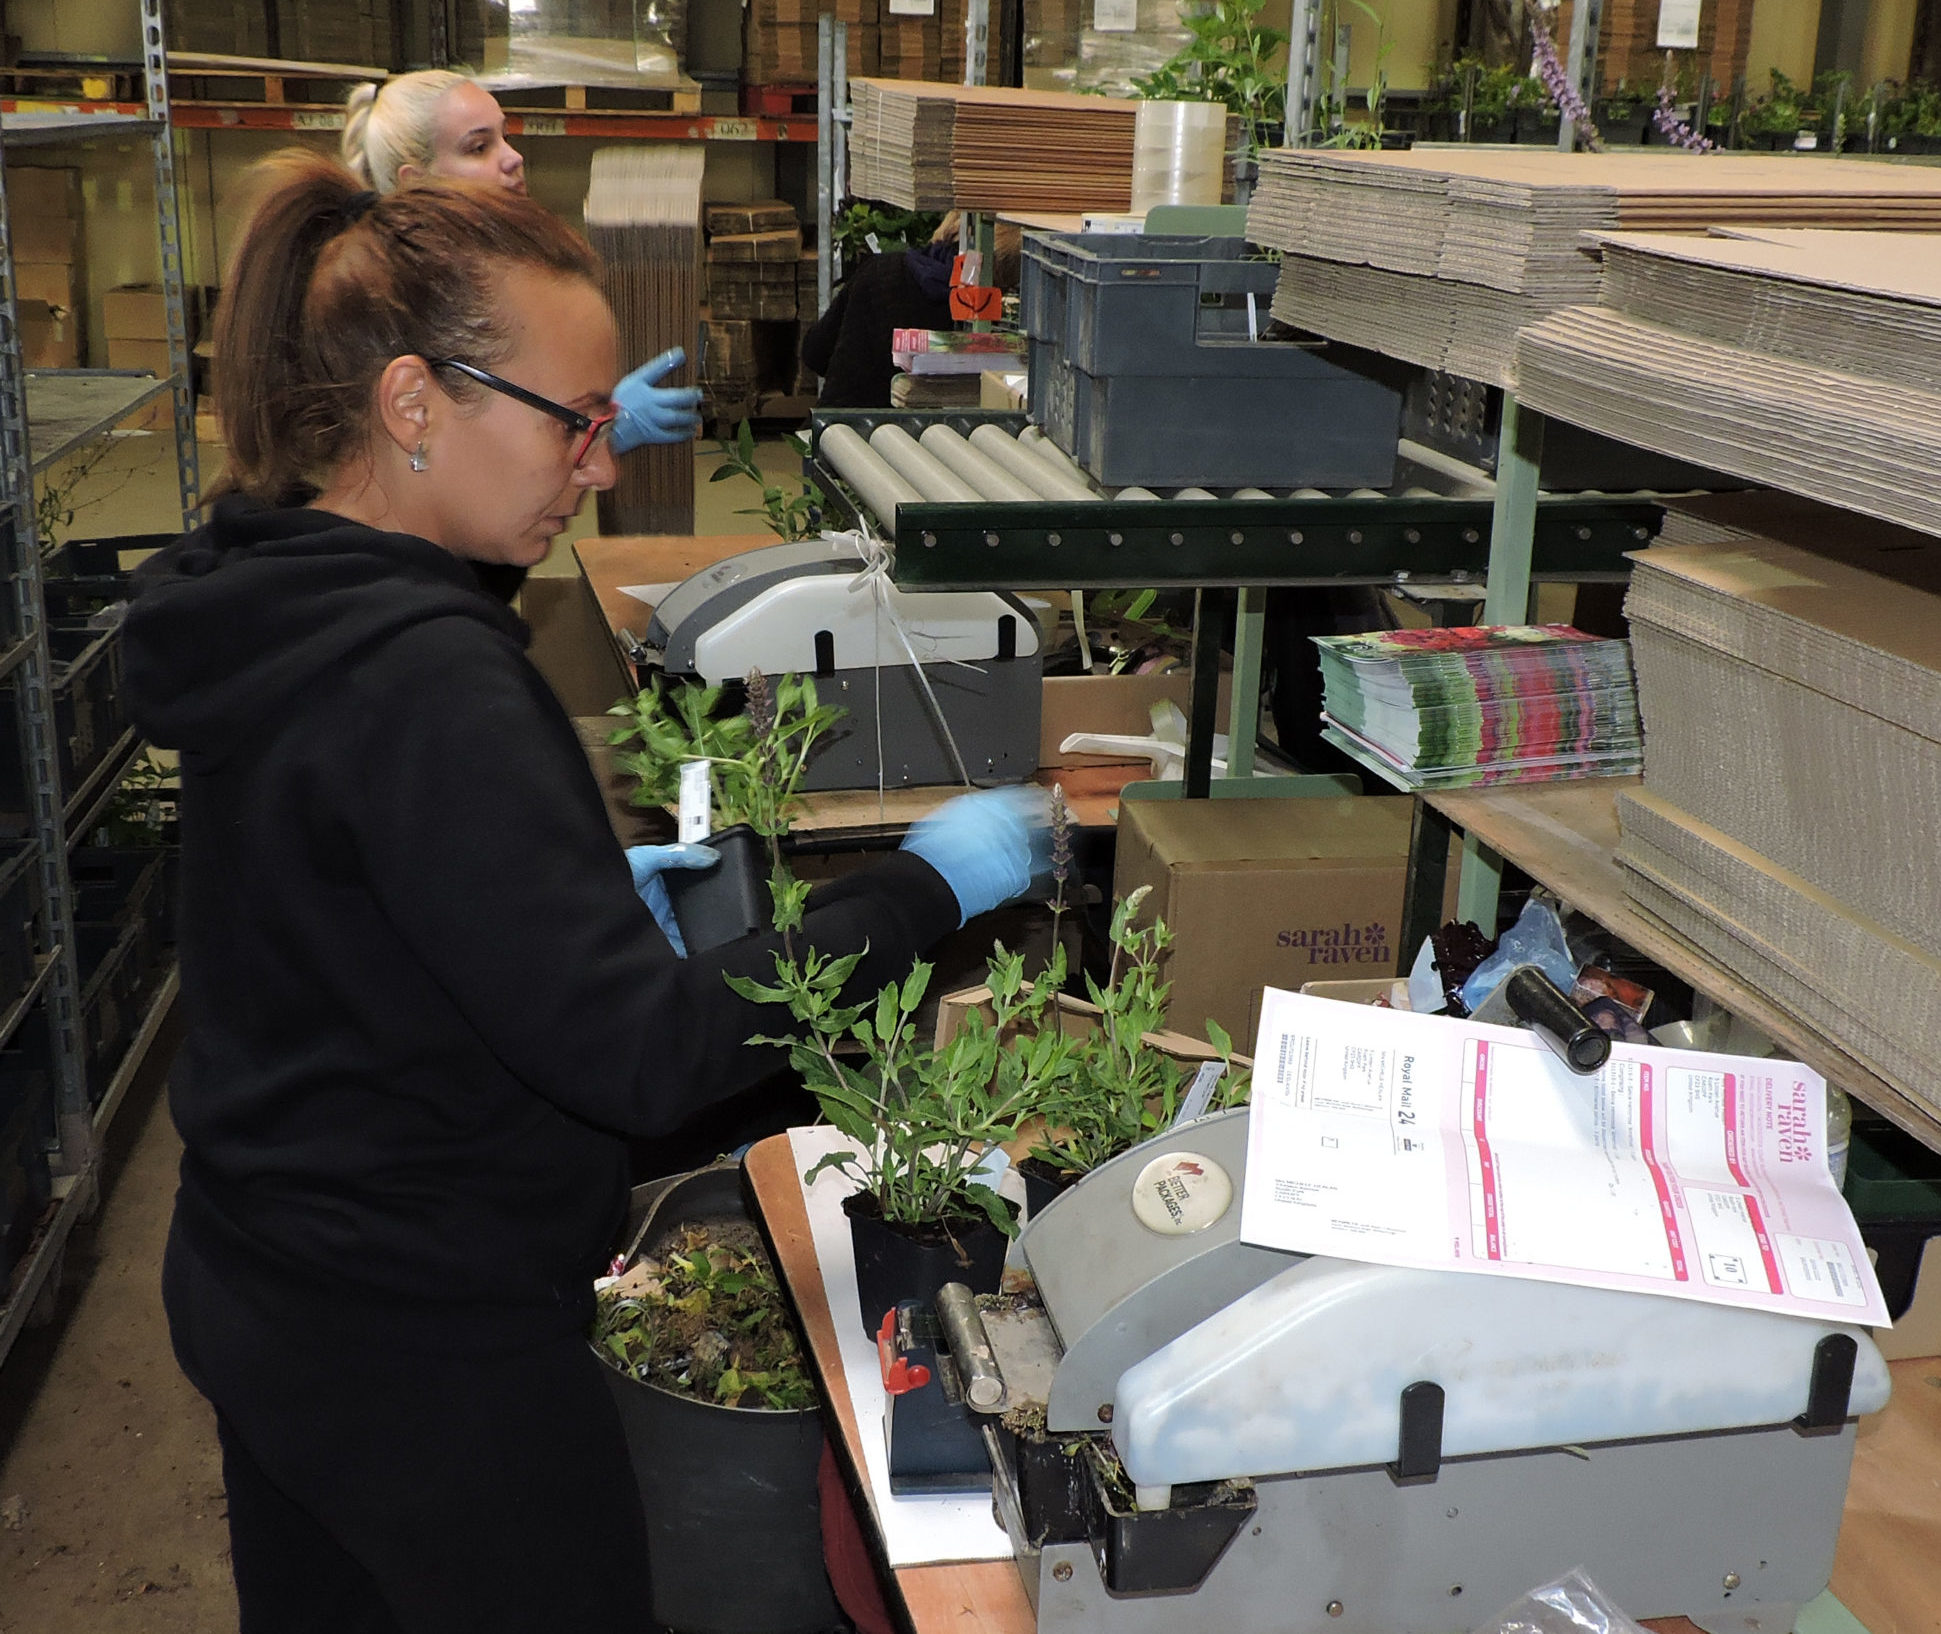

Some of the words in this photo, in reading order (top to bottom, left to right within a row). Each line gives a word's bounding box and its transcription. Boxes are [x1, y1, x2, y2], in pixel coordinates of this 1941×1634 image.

[1276, 923, 1361, 947] sarah
[1307, 946, 1390, 965] raven
[1400, 1055, 1415, 1084] Royal
[1401, 1086, 1413, 1108] Mail
[1765, 1077, 1774, 1110] DELIVERY
[1397, 1110, 1416, 1126] 24
[1765, 1110, 1774, 1130] NOTE
[1792, 1080, 1812, 1144] sarah
[1777, 1104, 1794, 1164] raven
[1167, 1175, 1190, 1201] BETTER
[1723, 1262, 1738, 1274] 10
